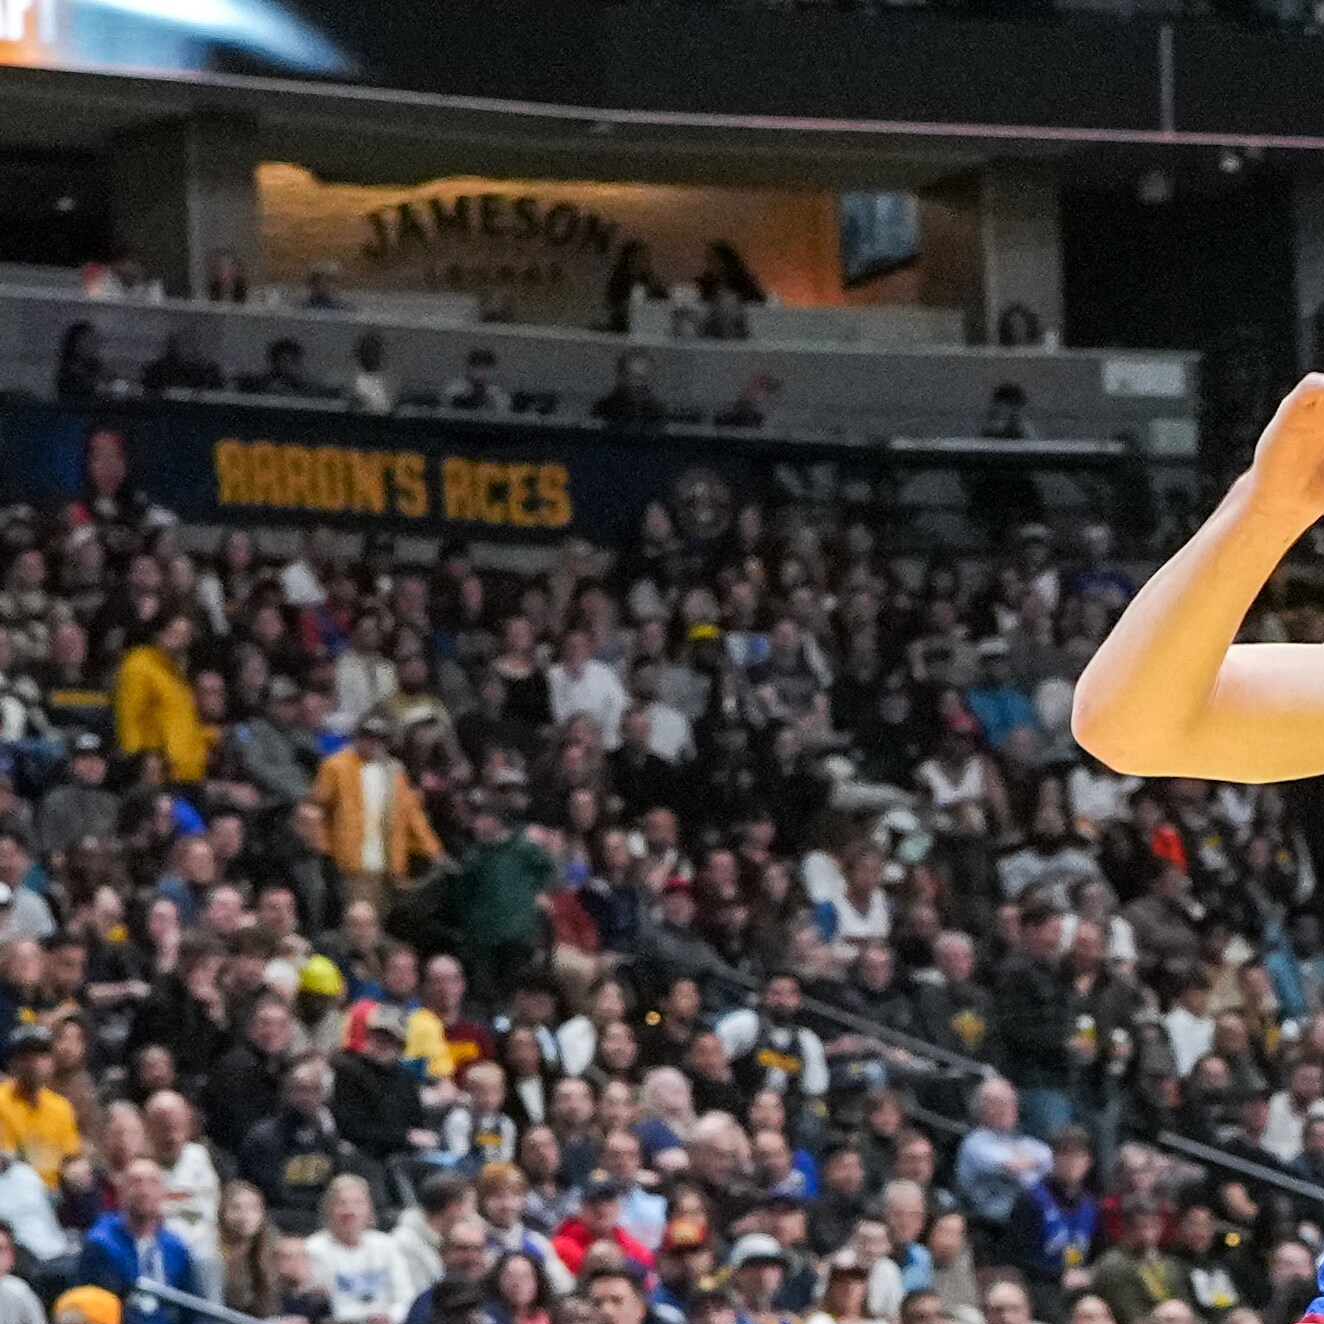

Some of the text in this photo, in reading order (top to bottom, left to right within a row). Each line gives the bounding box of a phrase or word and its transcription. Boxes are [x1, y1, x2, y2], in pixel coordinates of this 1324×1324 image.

[359, 191, 622, 263] JAMESON
[215, 438, 573, 528] AARON'S ACES
